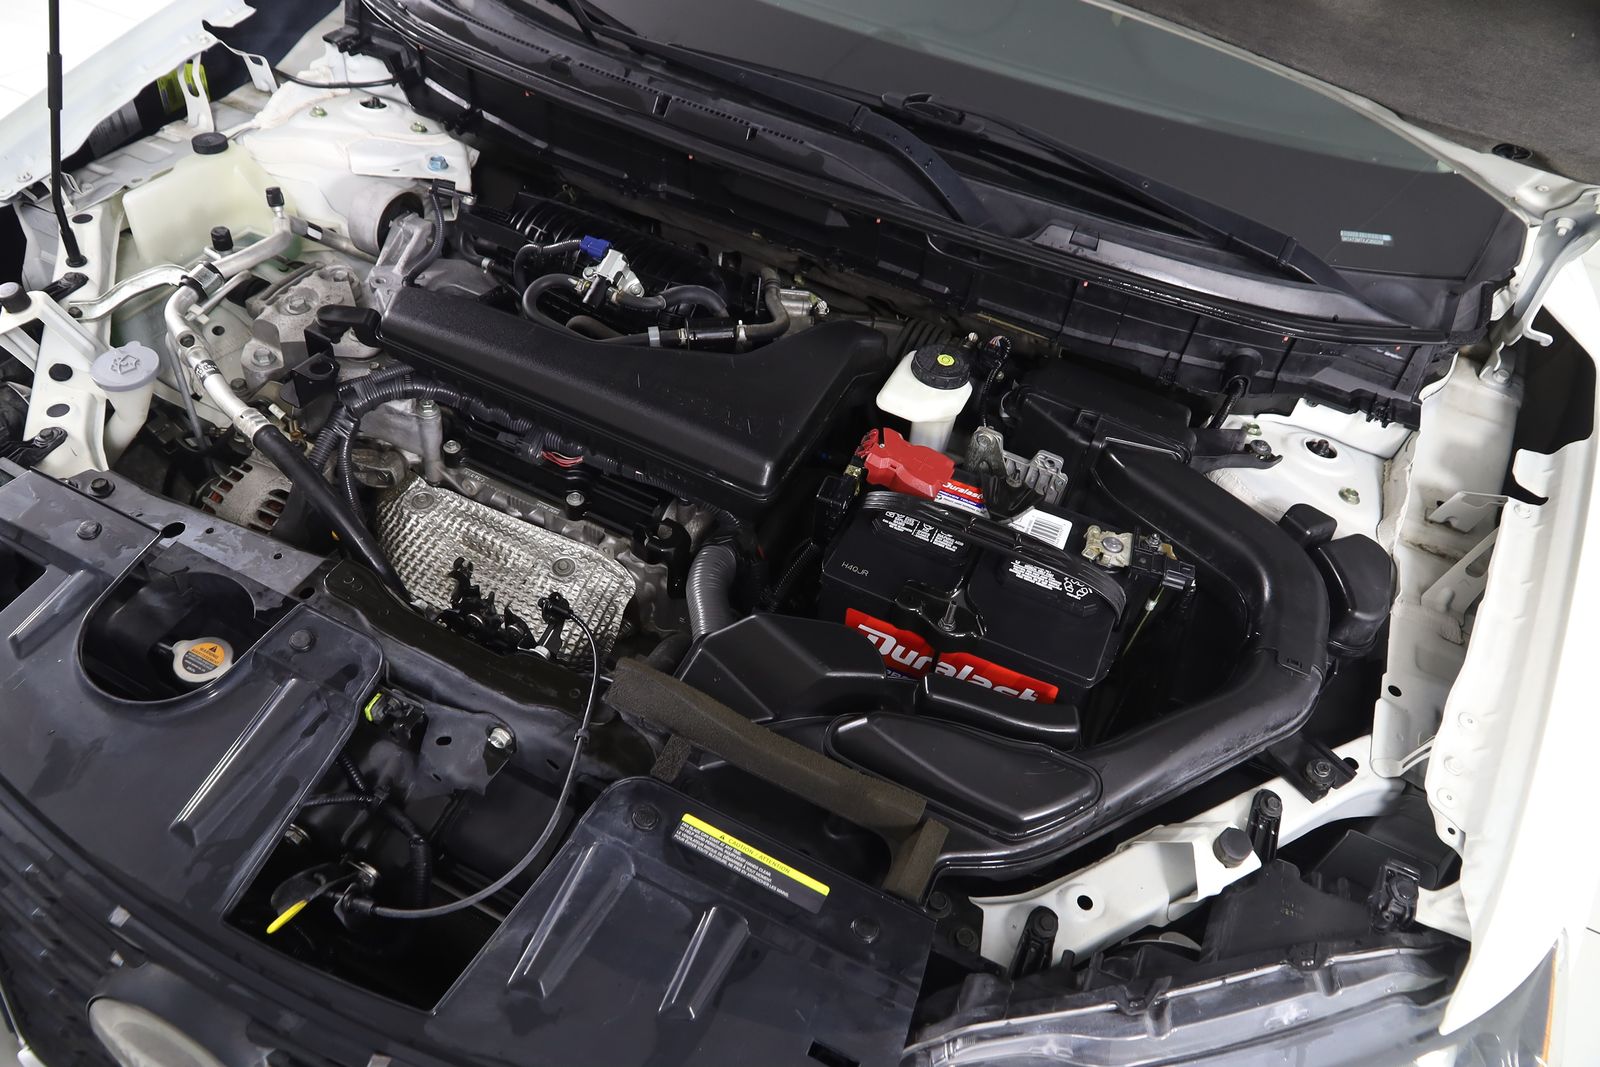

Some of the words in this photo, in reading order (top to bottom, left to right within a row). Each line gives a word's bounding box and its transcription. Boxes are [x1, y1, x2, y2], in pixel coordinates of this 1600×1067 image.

[688, 825, 700, 834] BLADE
[684, 828, 694, 836] HELP
[693, 833, 705, 842] AVOID
[745, 860, 758, 870] HANDS
[727, 837, 754, 854] CAUTION
[758, 853, 790, 874] ATTENTION
